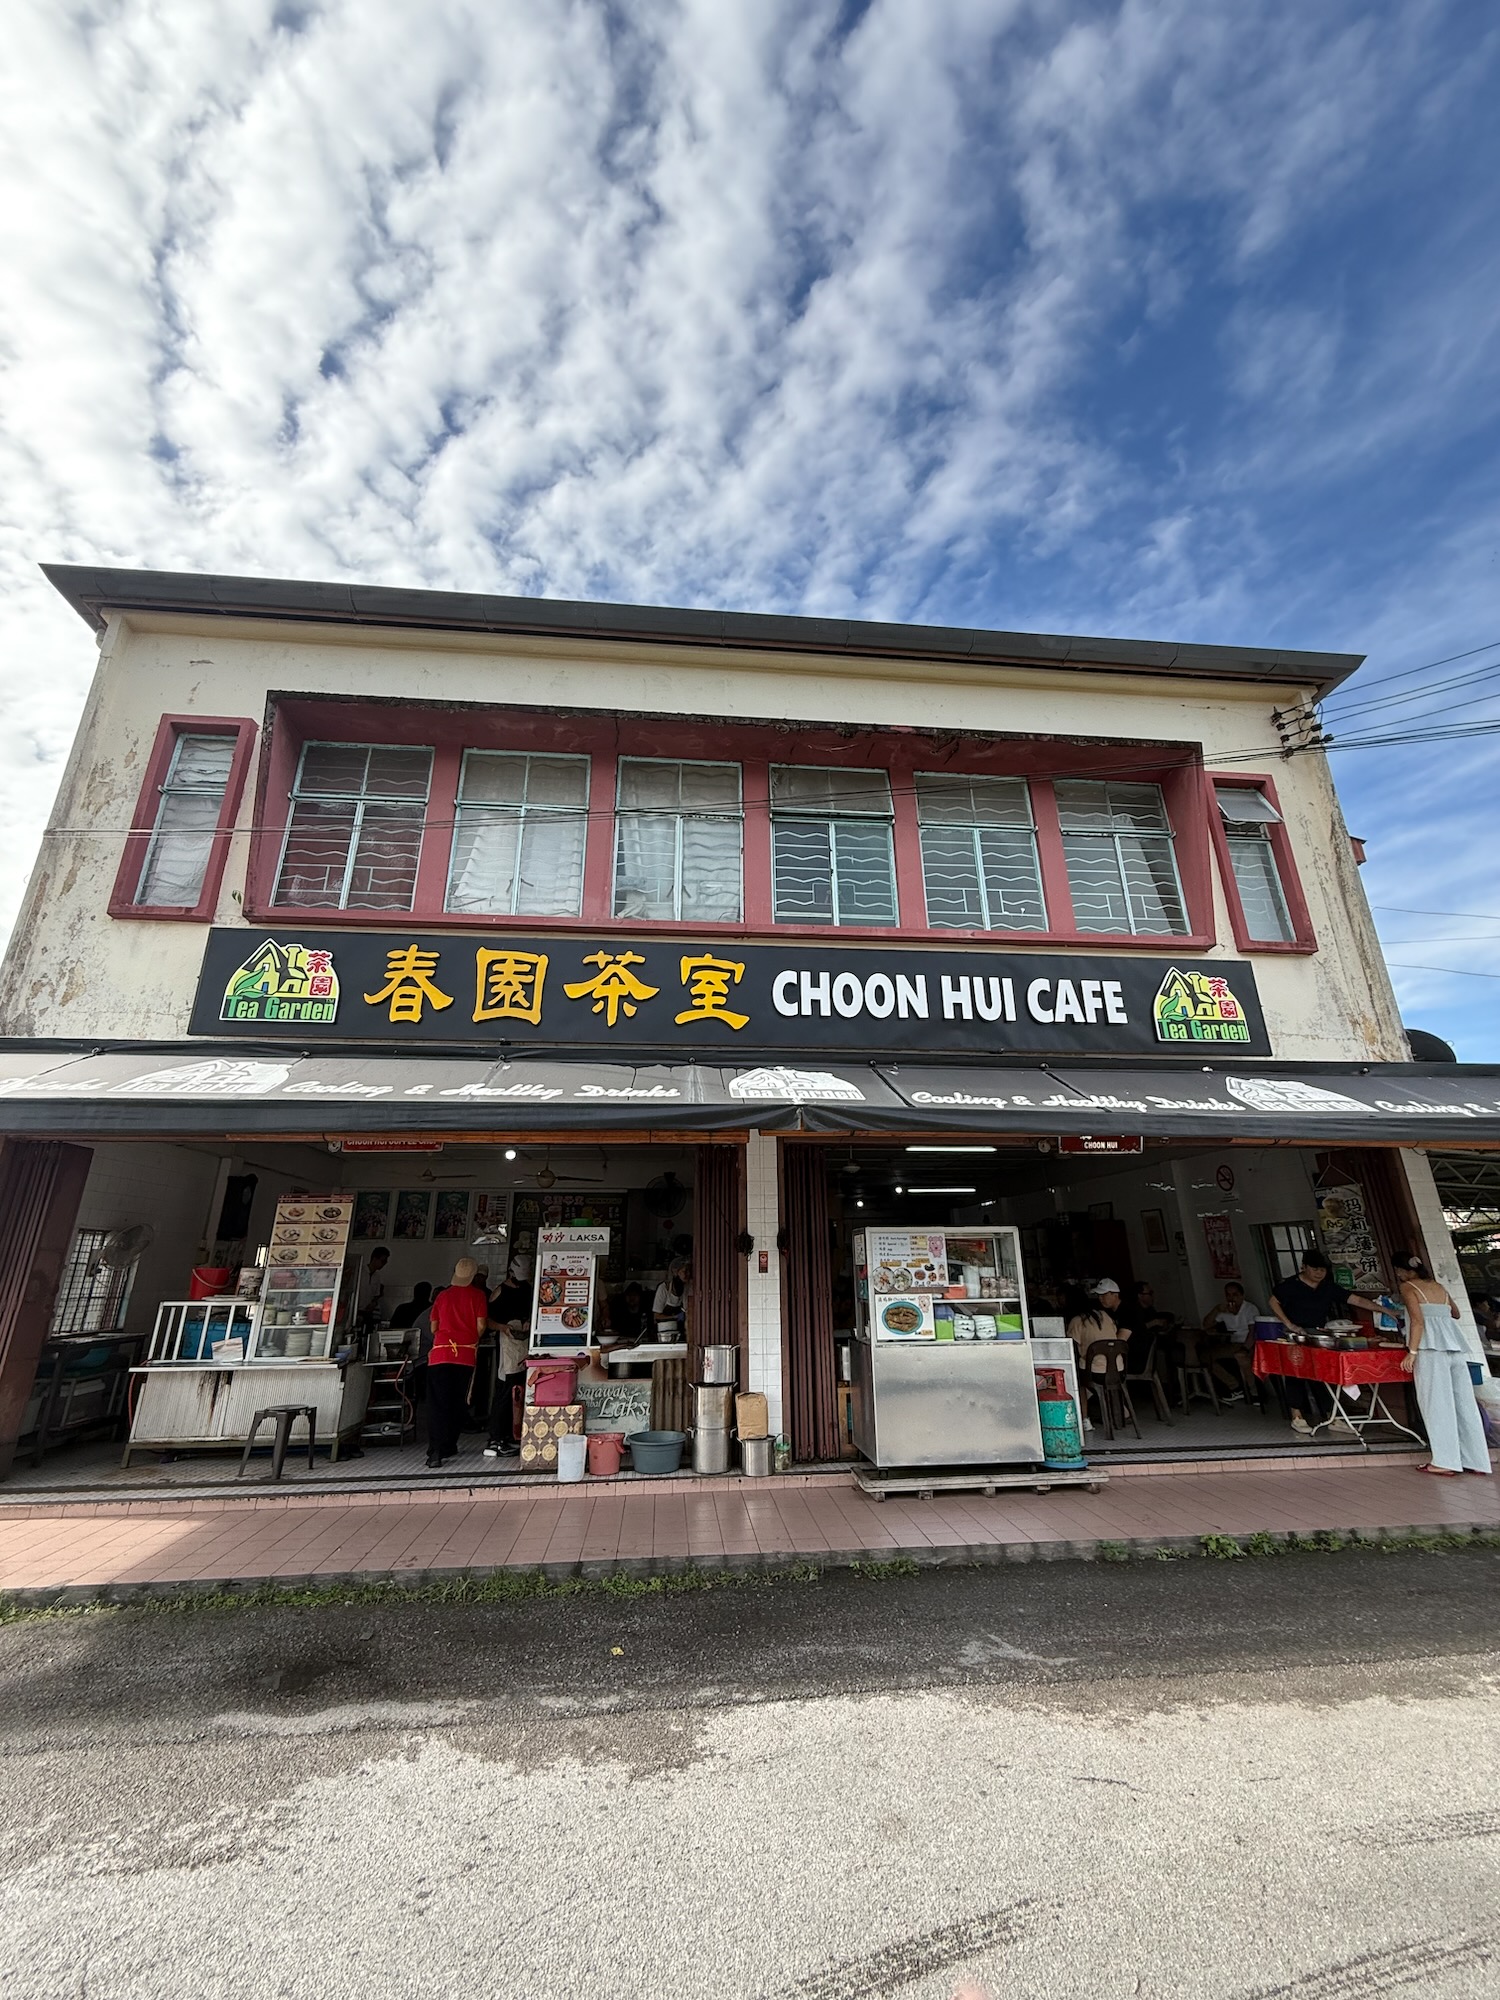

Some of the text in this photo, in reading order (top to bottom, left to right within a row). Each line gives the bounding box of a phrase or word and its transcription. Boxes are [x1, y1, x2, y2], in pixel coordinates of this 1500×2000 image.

[363, 943, 750, 1031] 春園茶室
[772, 970, 1128, 1025] CHOON HUI CAFE
[226, 996, 334, 1021] Tea Garden
[1158, 1019, 1248, 1040] Tea Garden
[282, 1080, 681, 1099] Cooling & Healthy Drinks
[732, 1087, 864, 1099] Tea Garden
[912, 1091, 1246, 1113] Cooling & Healthy Drinks
[1374, 1100, 1477, 1118] Cooling
[1464, 1103, 1498, 1113] &
[1083, 1141, 1118, 1150] CHOON HUI
[569, 1234, 605, 1242] LAKSA
[577, 1384, 628, 1401] Sarawak
